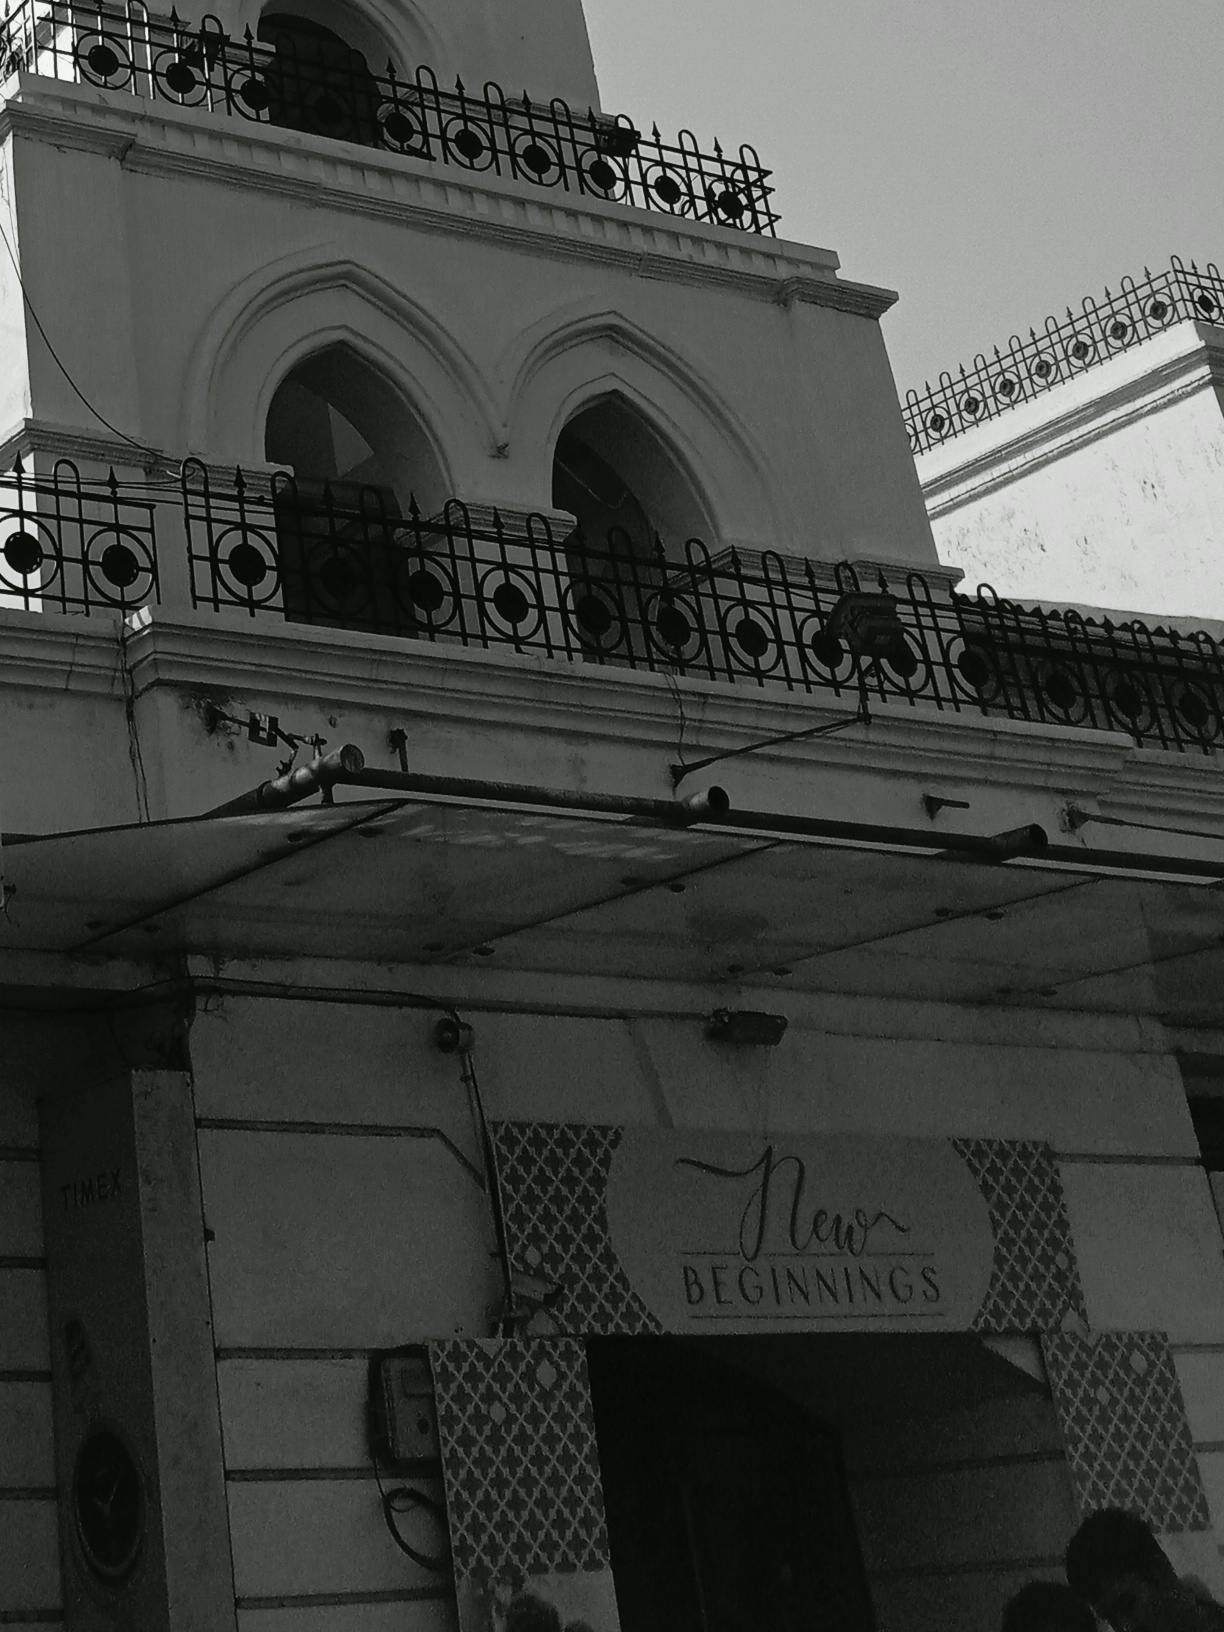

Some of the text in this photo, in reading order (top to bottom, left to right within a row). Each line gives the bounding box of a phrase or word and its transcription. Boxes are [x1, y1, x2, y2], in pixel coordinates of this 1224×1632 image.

[59, 1165, 122, 1212] TIMEX
[673, 1145, 911, 1263] New
[682, 1265, 941, 1306] BEGINNINGS
